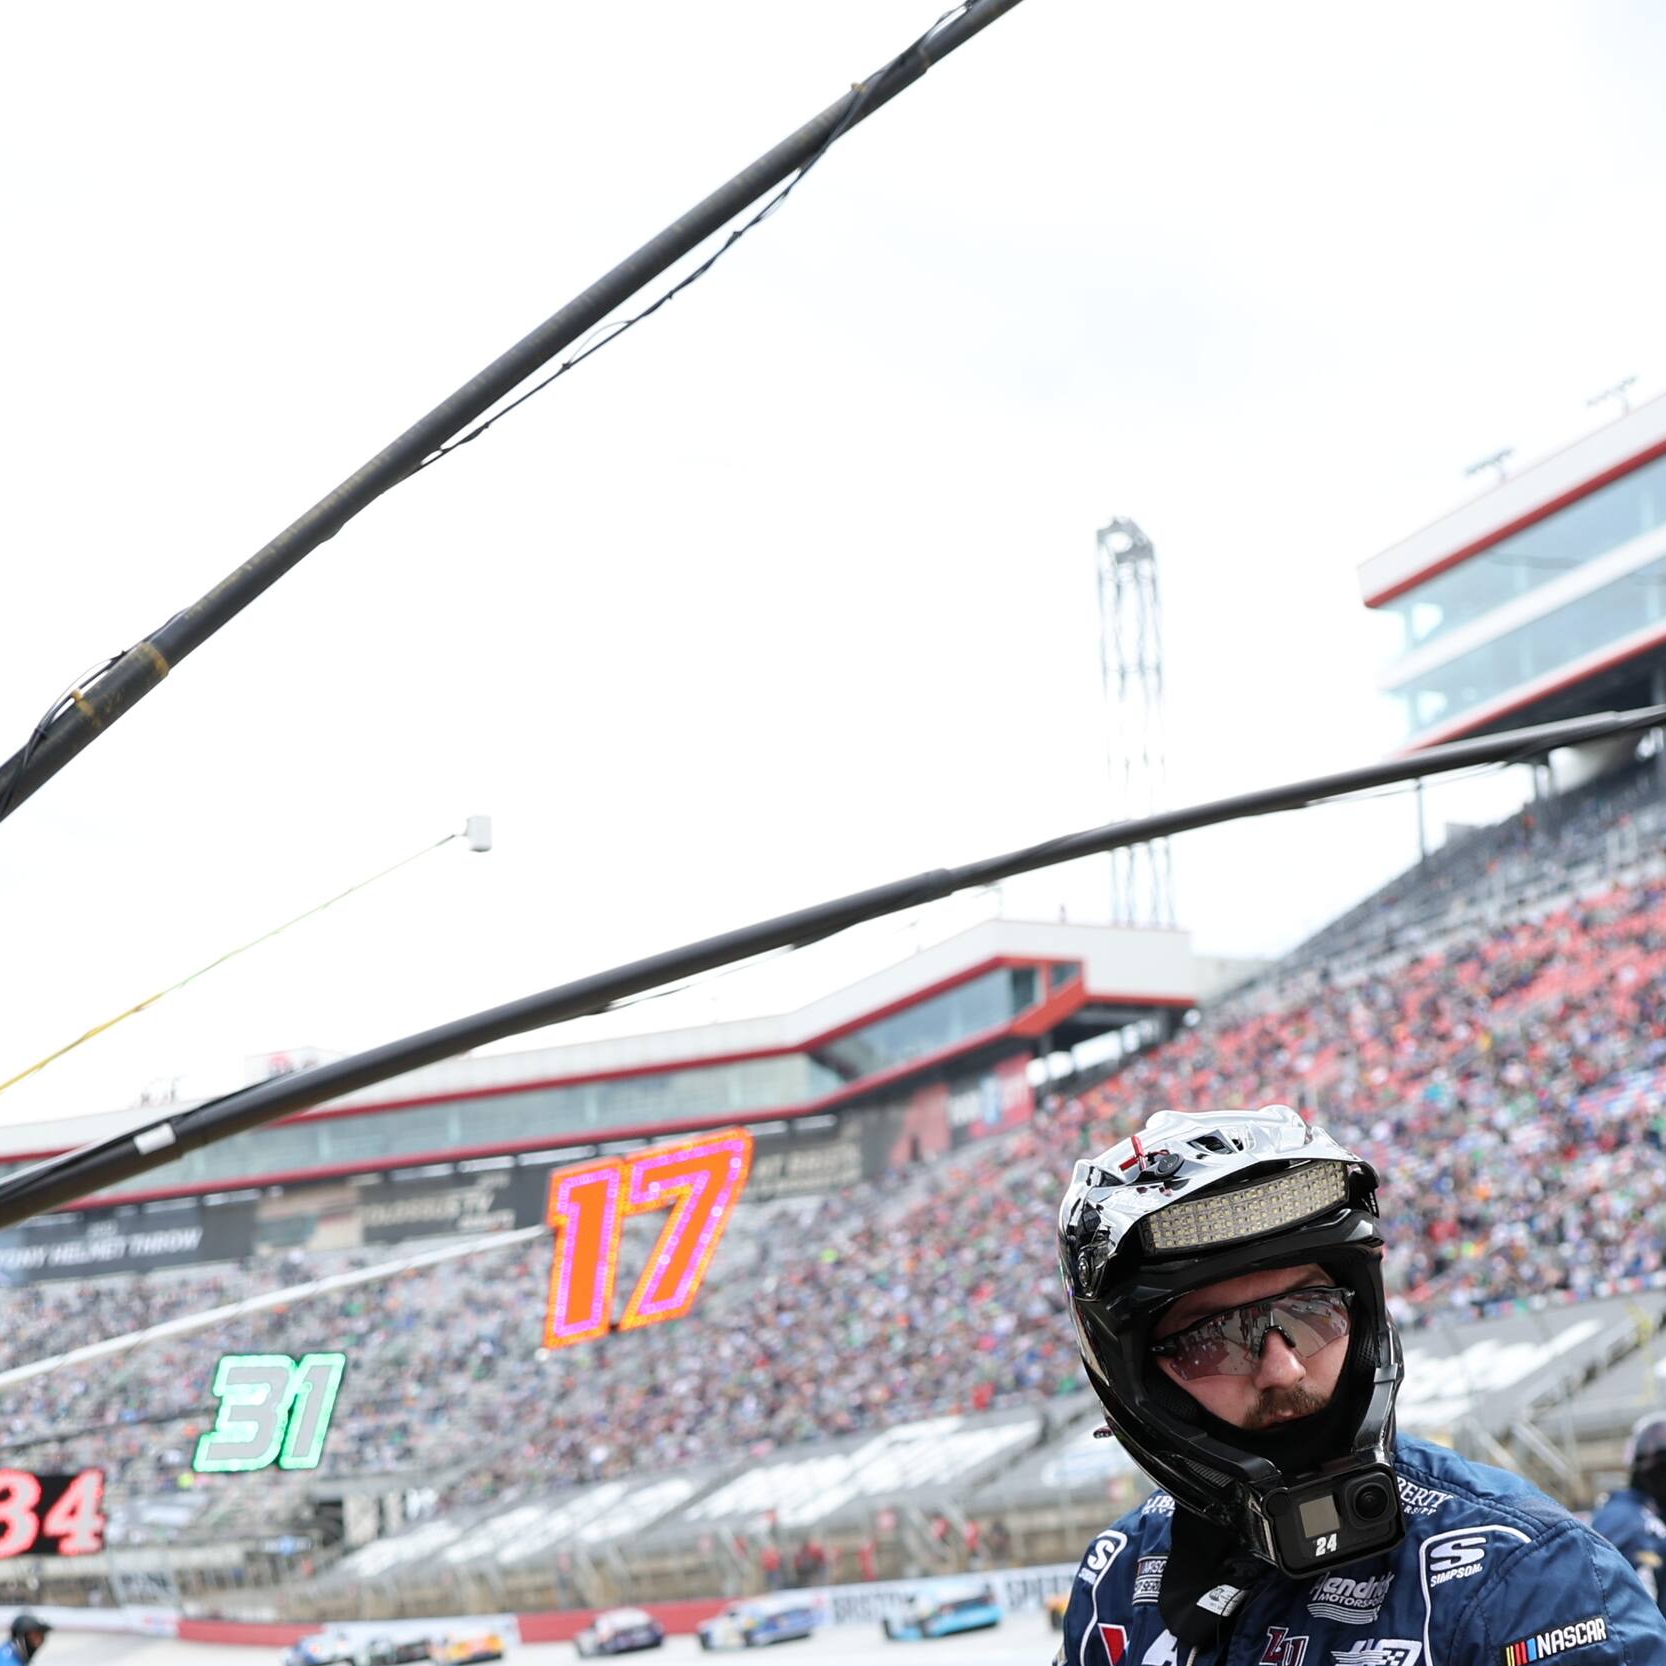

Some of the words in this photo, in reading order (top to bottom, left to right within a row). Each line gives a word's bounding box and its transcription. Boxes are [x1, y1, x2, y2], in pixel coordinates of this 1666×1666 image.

[542, 1126, 755, 1350] 17
[195, 1352, 347, 1474] 31
[1315, 1533, 1338, 1556] 24
[1536, 1616, 1608, 1660] NASCAR
